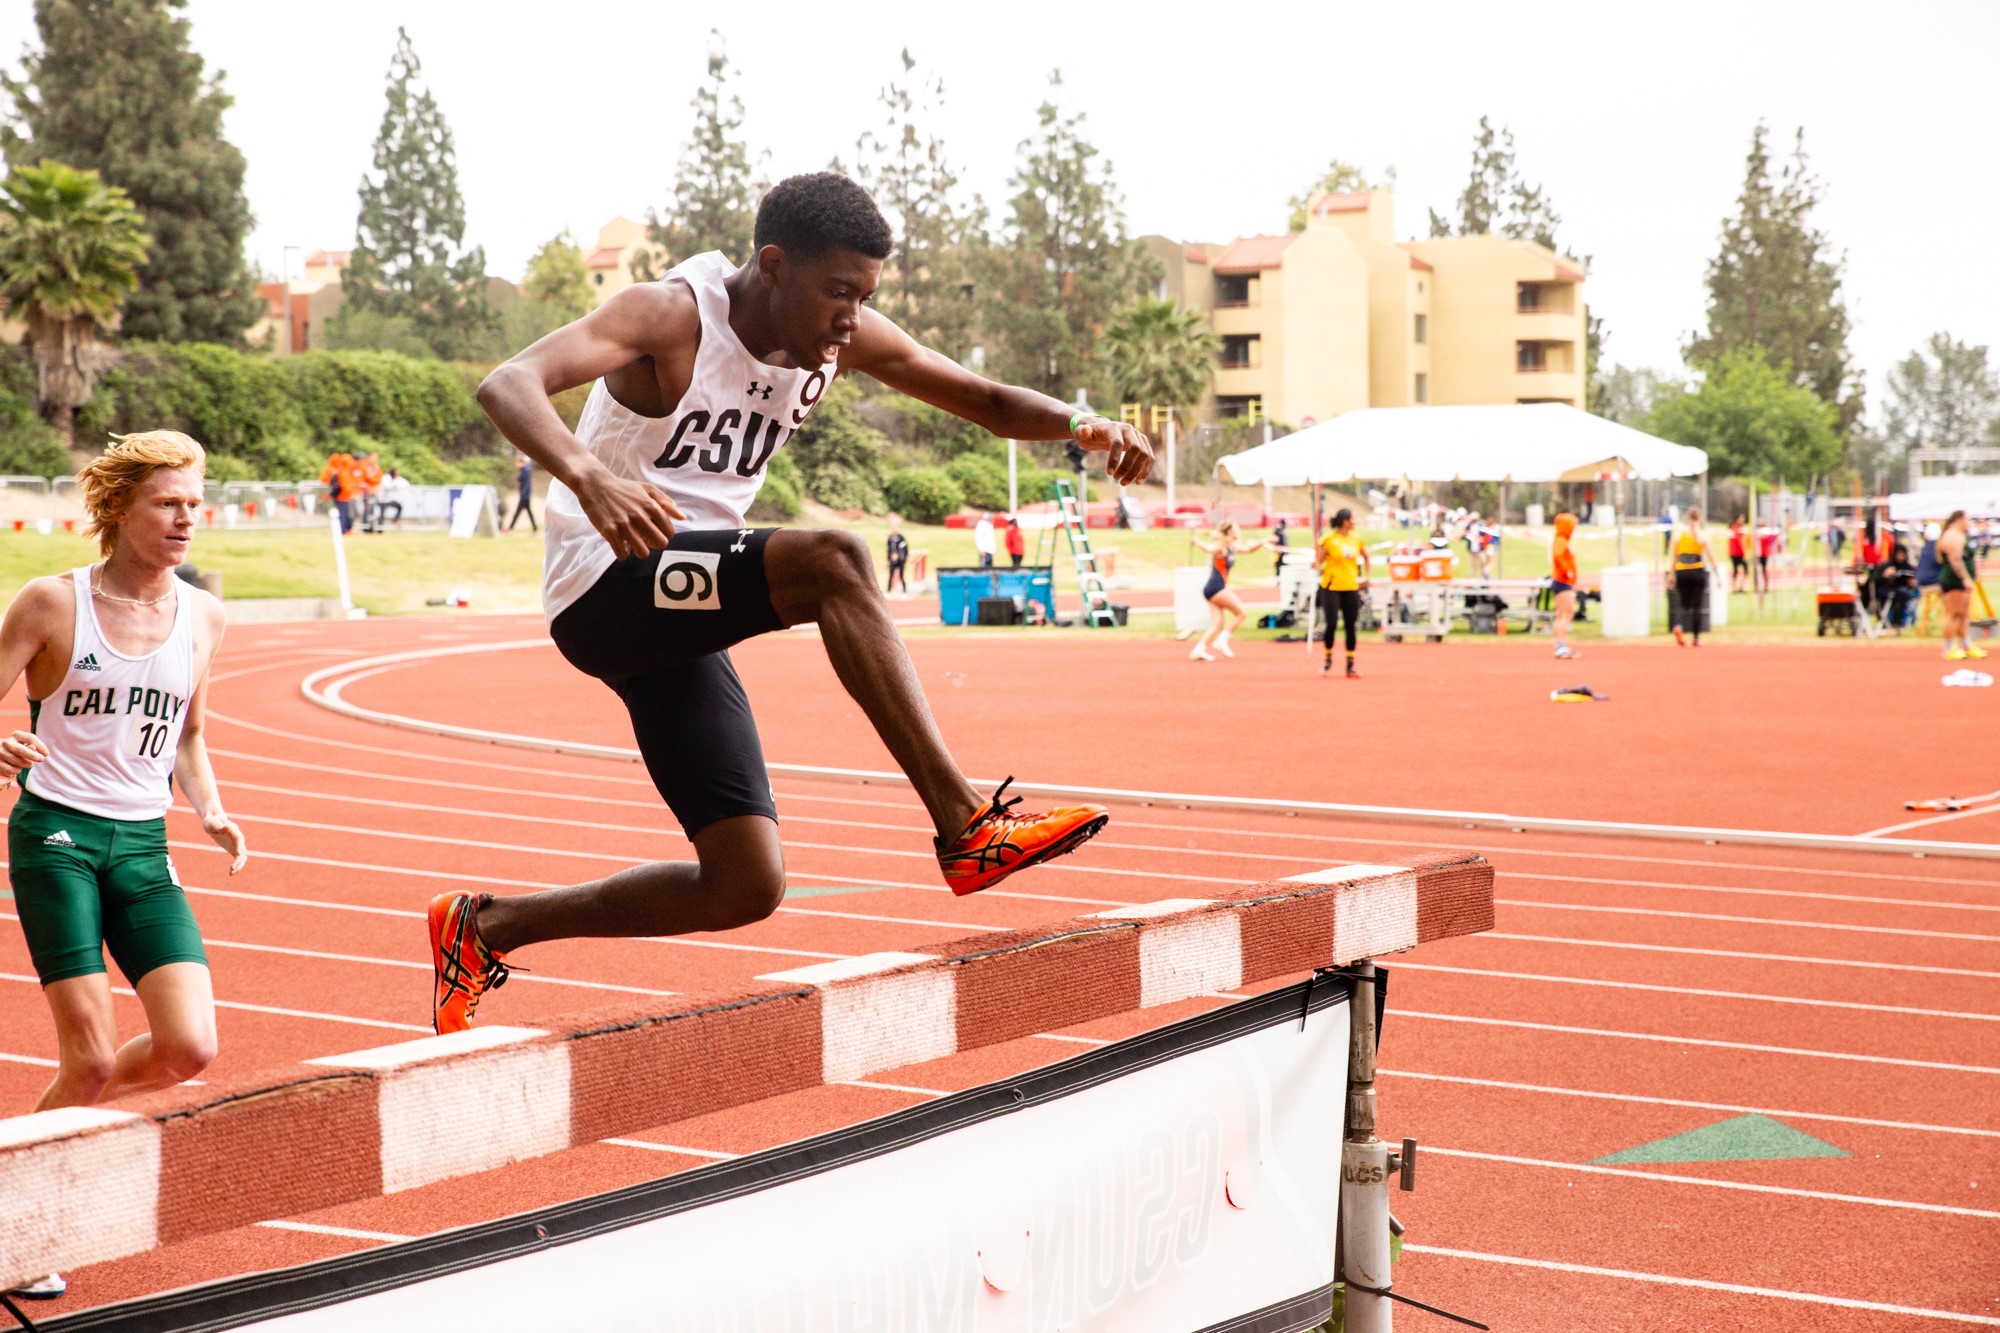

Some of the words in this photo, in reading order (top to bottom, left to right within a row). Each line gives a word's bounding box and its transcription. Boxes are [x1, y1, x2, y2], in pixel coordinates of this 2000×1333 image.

[791, 369, 826, 425] 9
[653, 408, 797, 478] CSU
[73, 662, 102, 672] adidas
[63, 687, 117, 717] CAL
[126, 686, 185, 724] POLY
[138, 722, 168, 759] 10
[43, 836, 77, 849] adidas
[1342, 1165, 1383, 1184] UCS
